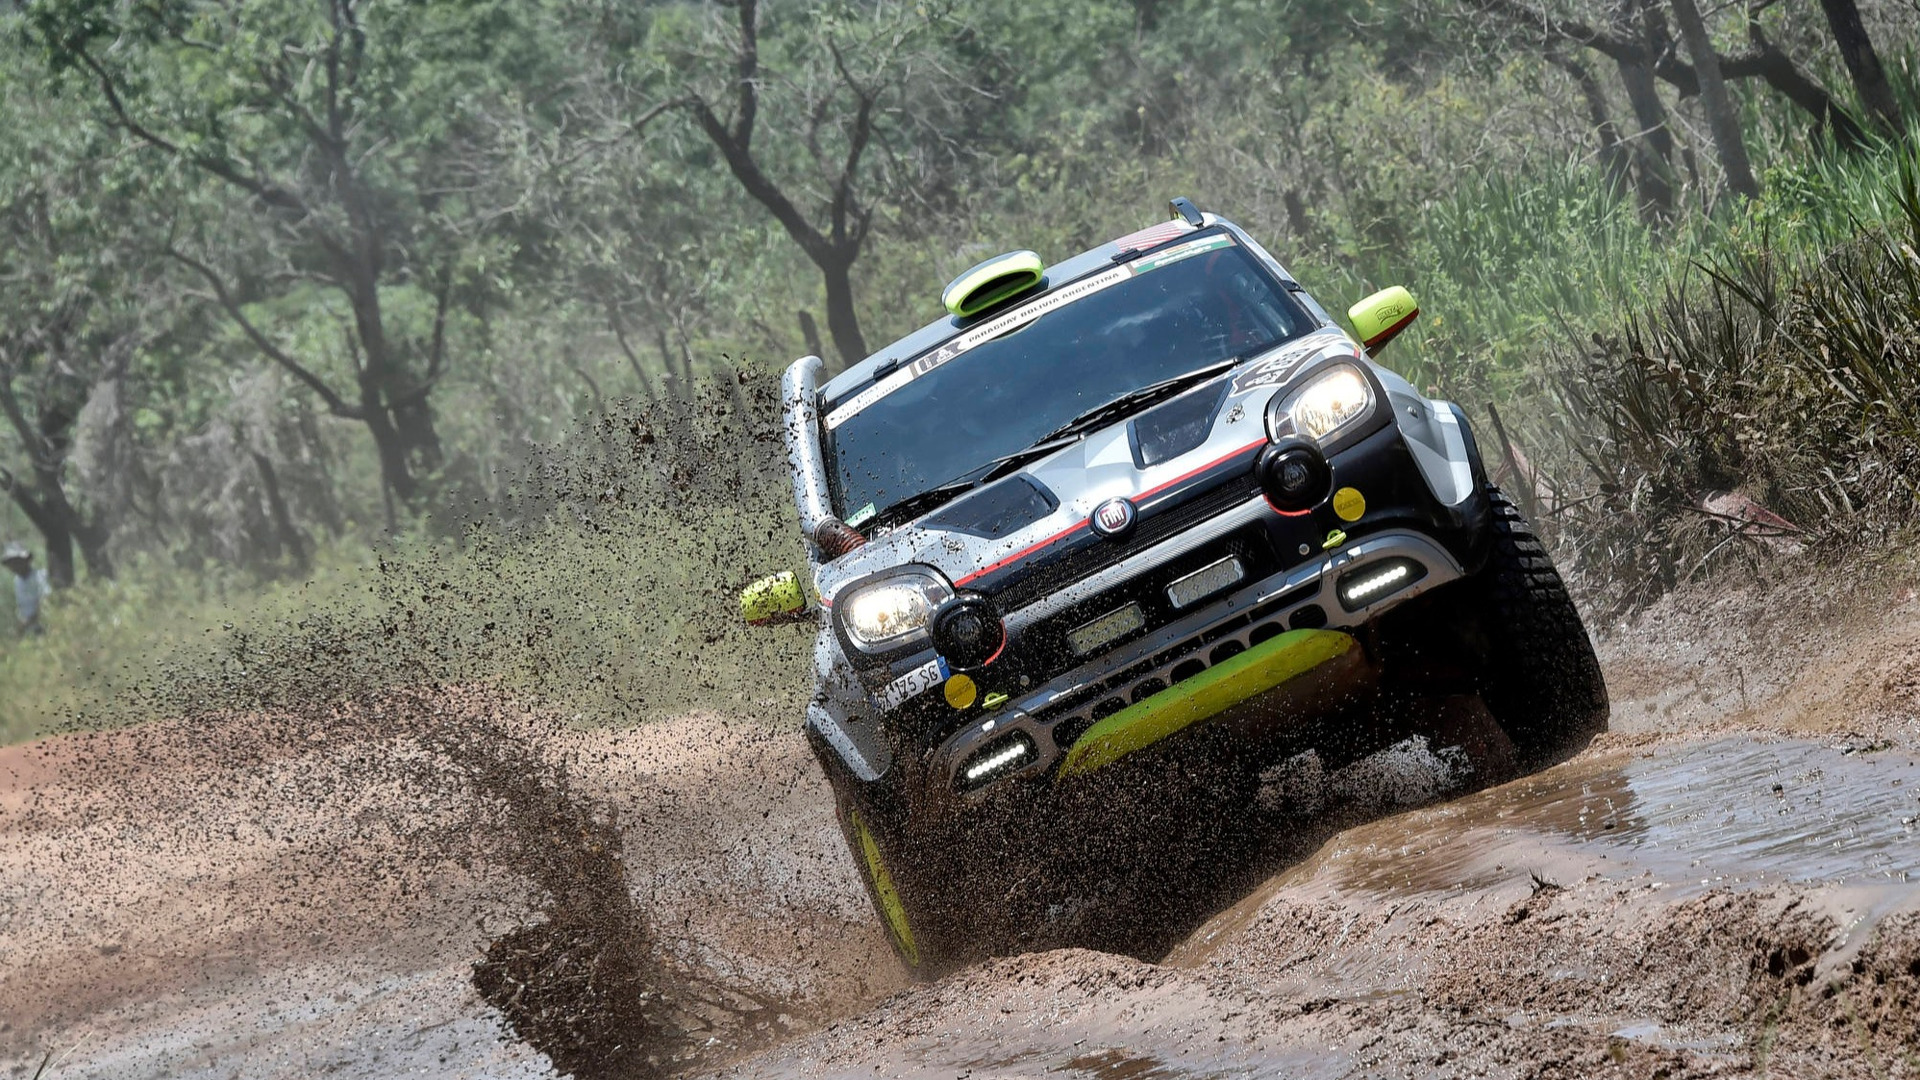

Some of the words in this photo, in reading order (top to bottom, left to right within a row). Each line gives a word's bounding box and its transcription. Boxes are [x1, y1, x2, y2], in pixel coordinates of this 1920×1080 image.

[968, 315, 1017, 343] PARAGUAY
[1020, 297, 1059, 318] BOLIVIA
[1062, 273, 1120, 299] ARGENTINA
[1101, 503, 1124, 527] FIAT
